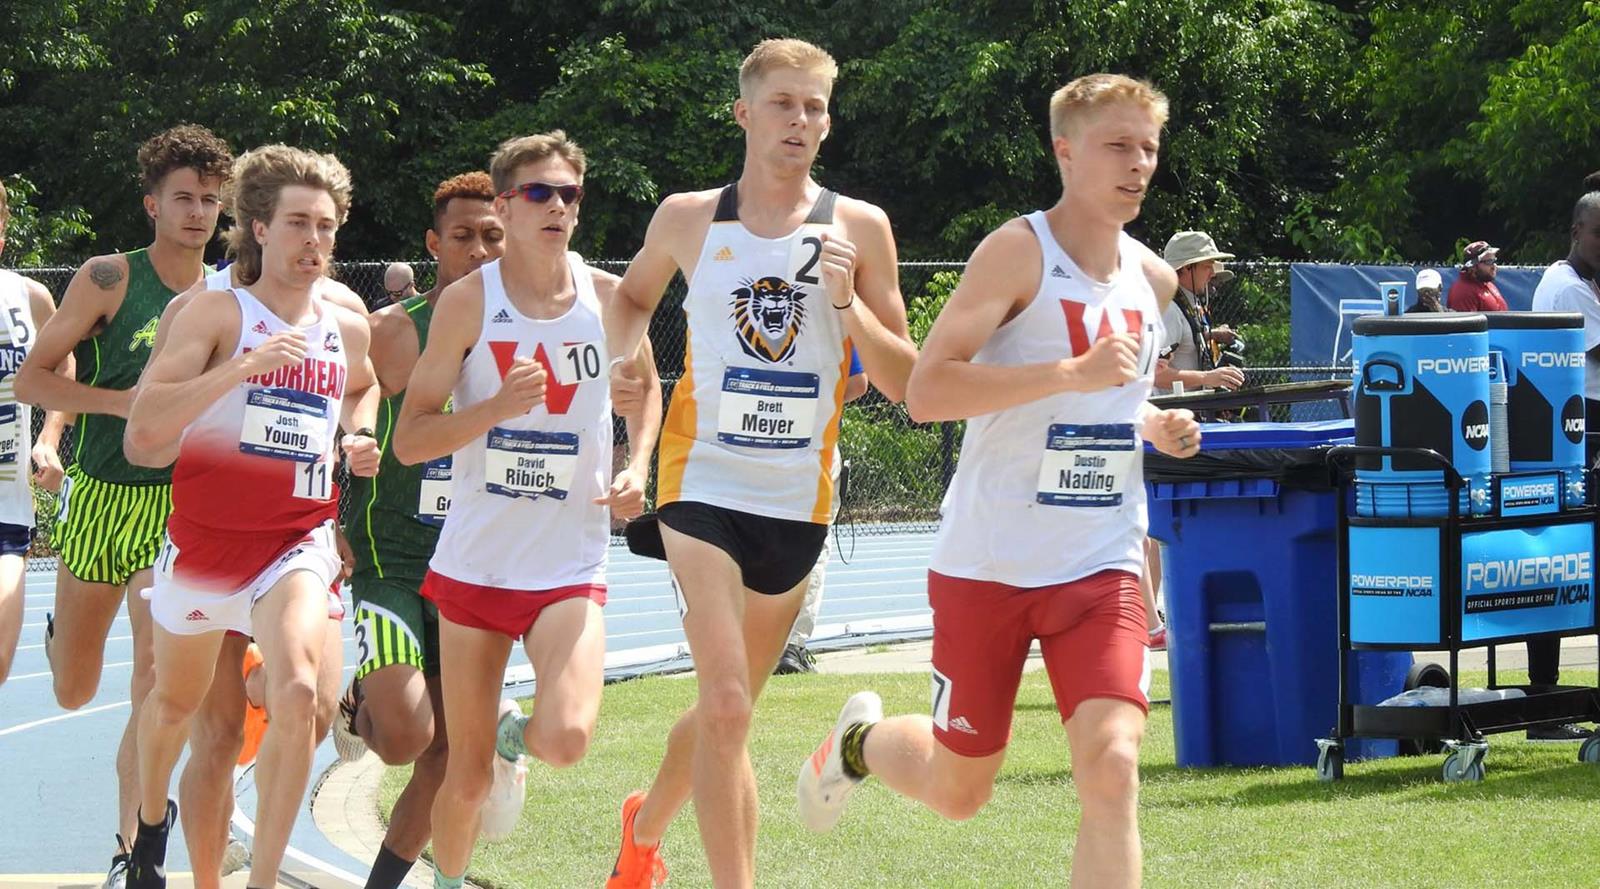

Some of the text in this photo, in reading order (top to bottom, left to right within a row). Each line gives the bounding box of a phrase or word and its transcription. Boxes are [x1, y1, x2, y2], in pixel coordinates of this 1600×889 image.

[795, 236, 822, 285] 2
[8, 307, 30, 344] 5
[567, 344, 601, 381] 10
[757, 400, 783, 413] Brett
[276, 415, 299, 427] Josh
[742, 413, 794, 436] Meyer
[264, 426, 308, 449] Young
[517, 457, 545, 469] David
[1074, 455, 1107, 468] Dustin
[304, 463, 327, 497] 11
[505, 468, 555, 488] Ribich
[1058, 469, 1115, 492] Nading
[1504, 483, 1555, 499] POWERADE
[1352, 575, 1433, 588] POWERADE
[1466, 552, 1591, 591] POWERADE
[1405, 588, 1433, 597] NCAA
[1467, 583, 1590, 609] OFFICIAL SPORTS DRINK OF THE NCAA
[355, 624, 369, 665] 3
[933, 671, 946, 719] 7
